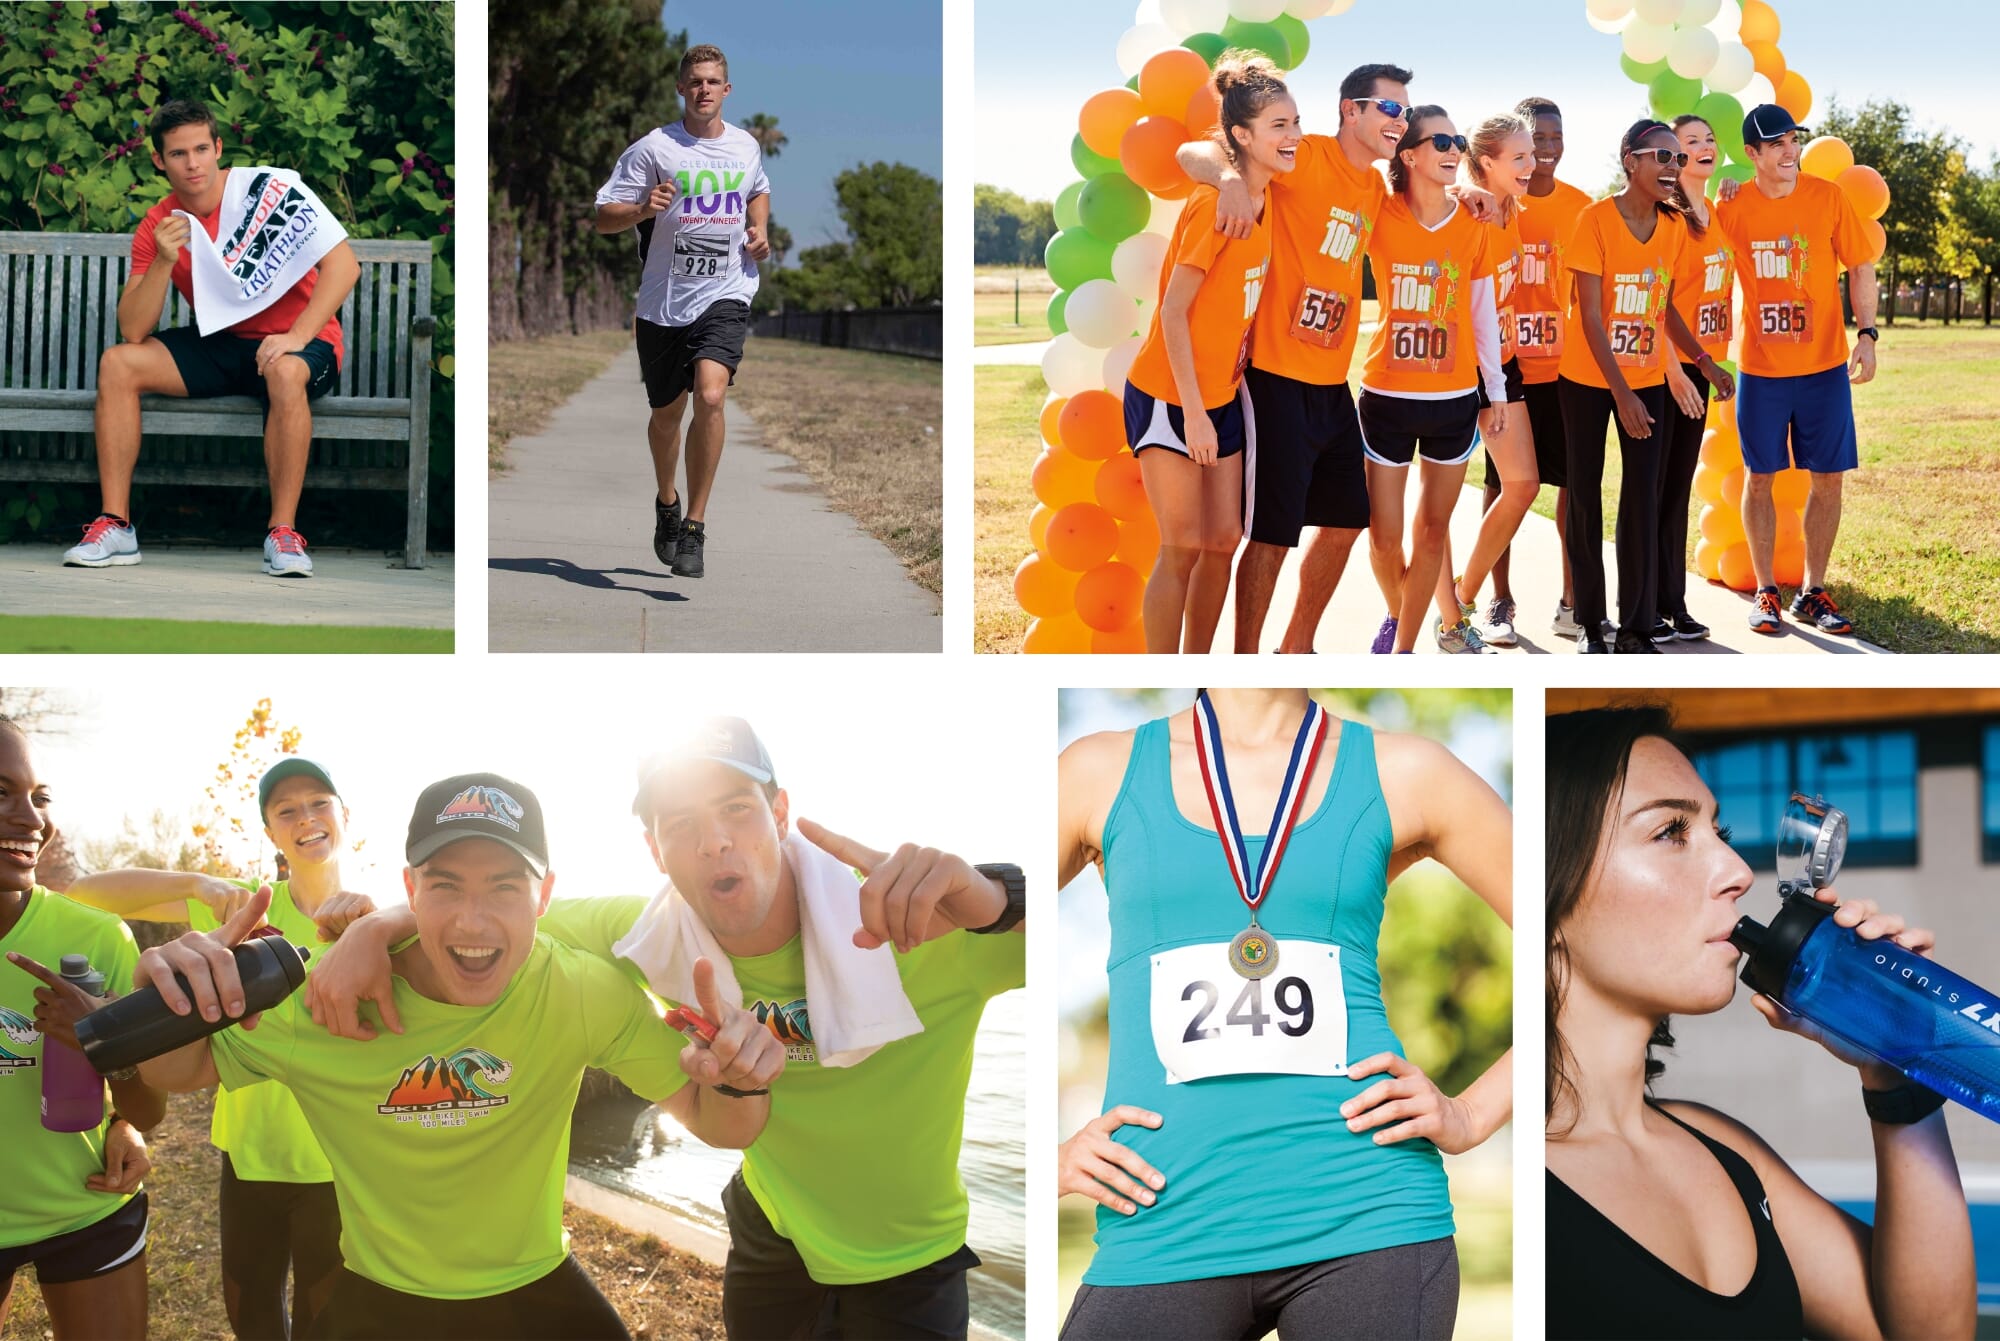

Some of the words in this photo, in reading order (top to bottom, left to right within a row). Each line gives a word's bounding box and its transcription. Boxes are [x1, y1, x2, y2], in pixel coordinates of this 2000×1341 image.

[680, 160, 745, 169] CLEVELAND
[676, 170, 745, 215] 10K
[679, 216, 708, 225] TWENTY
[710, 217, 741, 225] NINETEEN
[242, 203, 318, 297] TRIATHLON
[295, 226, 318, 250] EVENT
[686, 257, 717, 276] 928
[1301, 293, 1346, 333] 559
[1700, 305, 1728, 335] 586
[1763, 307, 1806, 333] 585
[1395, 326, 1448, 359] 600
[1520, 317, 1557, 345] 545
[1613, 325, 1654, 355] 523
[1875, 954, 1959, 1003] STUDIO
[1181, 976, 1314, 1043] 249
[380, 1104, 417, 1113] SKI
[423, 1101, 453, 1111] TO
[459, 1097, 506, 1107] SEA
[441, 1118, 466, 1126] MILES
